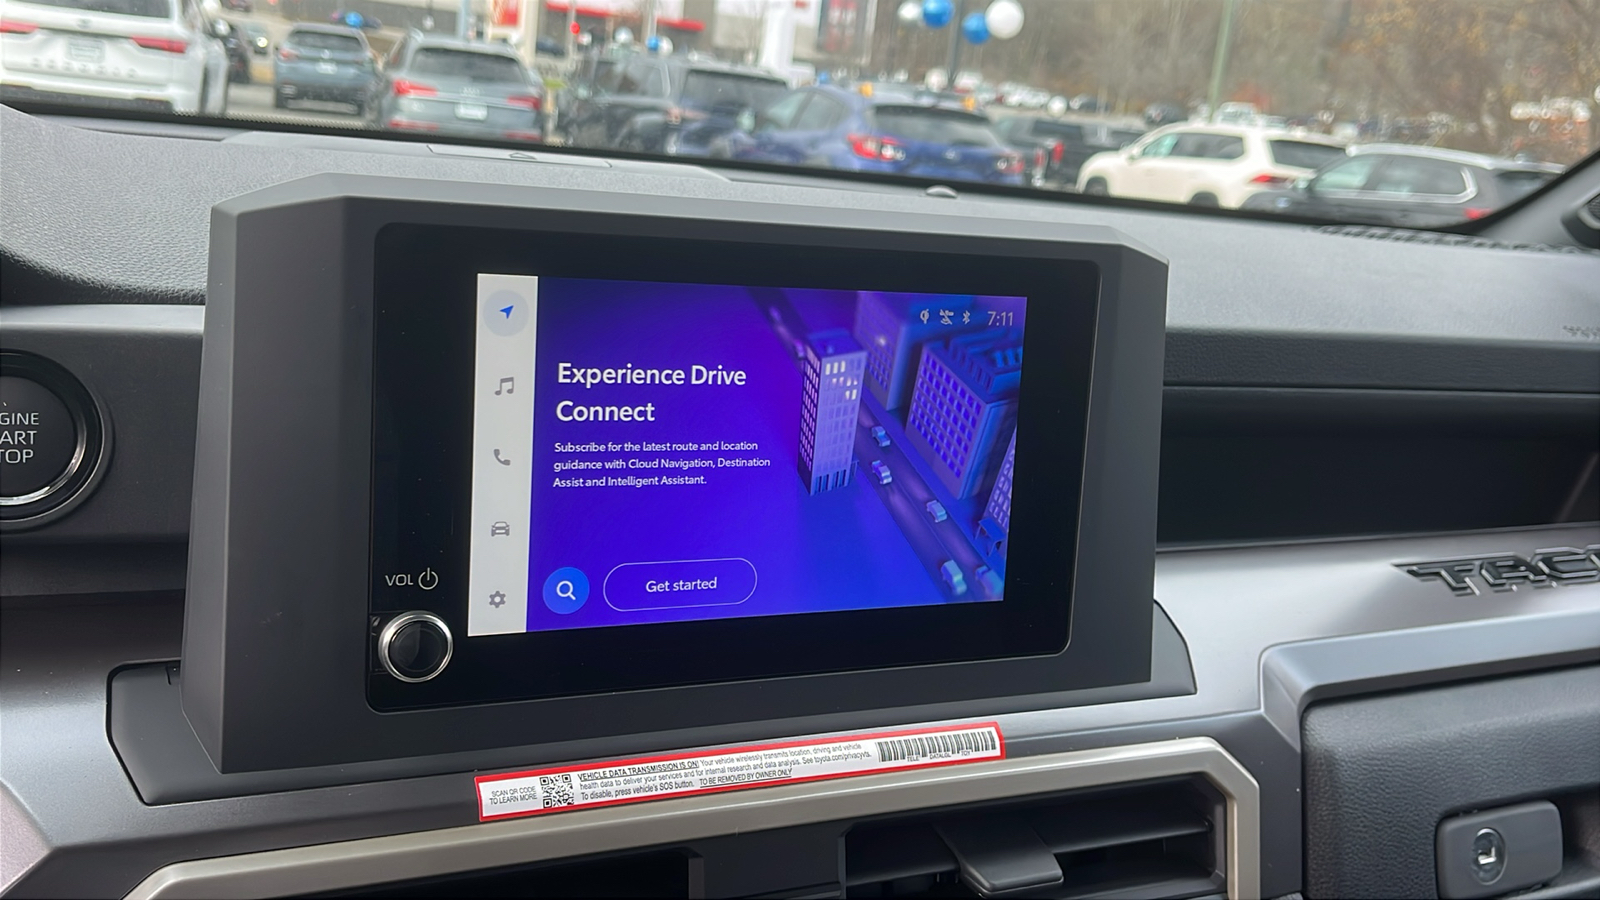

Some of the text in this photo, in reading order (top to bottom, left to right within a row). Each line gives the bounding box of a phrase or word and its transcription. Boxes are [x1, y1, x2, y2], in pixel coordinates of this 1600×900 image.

[987, 311, 1013, 326] 7:11
[558, 363, 746, 388] Experience Drive
[0, 412, 39, 425] GINE
[556, 401, 655, 421] Connect
[0, 430, 37, 445] ART
[554, 441, 758, 453] Subscribe for the latest route and location
[553, 457, 770, 472] guidance with Cloud Navigation, Destination
[553, 475, 707, 488] Assist and Intelligent Assistant.
[1393, 545, 1600, 595] TAC
[385, 574, 414, 586] VOL
[645, 576, 718, 593] Get started
[577, 770, 608, 781] VEHICLE
[608, 768, 627, 779] DATA
[627, 762, 679, 777] TRANSMISSION
[679, 761, 686, 772] IS
[686, 760, 699, 771] ON!
[700, 759, 714, 767] Your
[715, 756, 735, 765] vehicle
[735, 753, 763, 763] wirelessly
[763, 751, 789, 760] transmits
[789, 749, 812, 757] location,
[812, 747, 832, 755] driving
[843, 743, 862, 751] vehicle
[580, 782, 600, 790] health
[600, 780, 614, 788] data
[622, 776, 643, 785] deliver
[643, 776, 657, 784] your
[658, 772, 683, 781] services
[683, 770, 695, 778] and
[695, 768, 704, 776] for
[704, 766, 726, 776] internal
[727, 763, 752, 773] research
[752, 762, 764, 770] and
[764, 760, 778, 769] data
[777, 758, 802, 768] analysis.
[801, 756, 814, 765] See
[699, 767, 793, 786] TO BE REMOVED BY OWNER ONLY
[491, 789, 509, 798] SCAN
[519, 786, 536, 794] CODE
[581, 780, 695, 801] To disable, press vehicle's SOS button.
[489, 792, 538, 805] TO LEARN MORE
